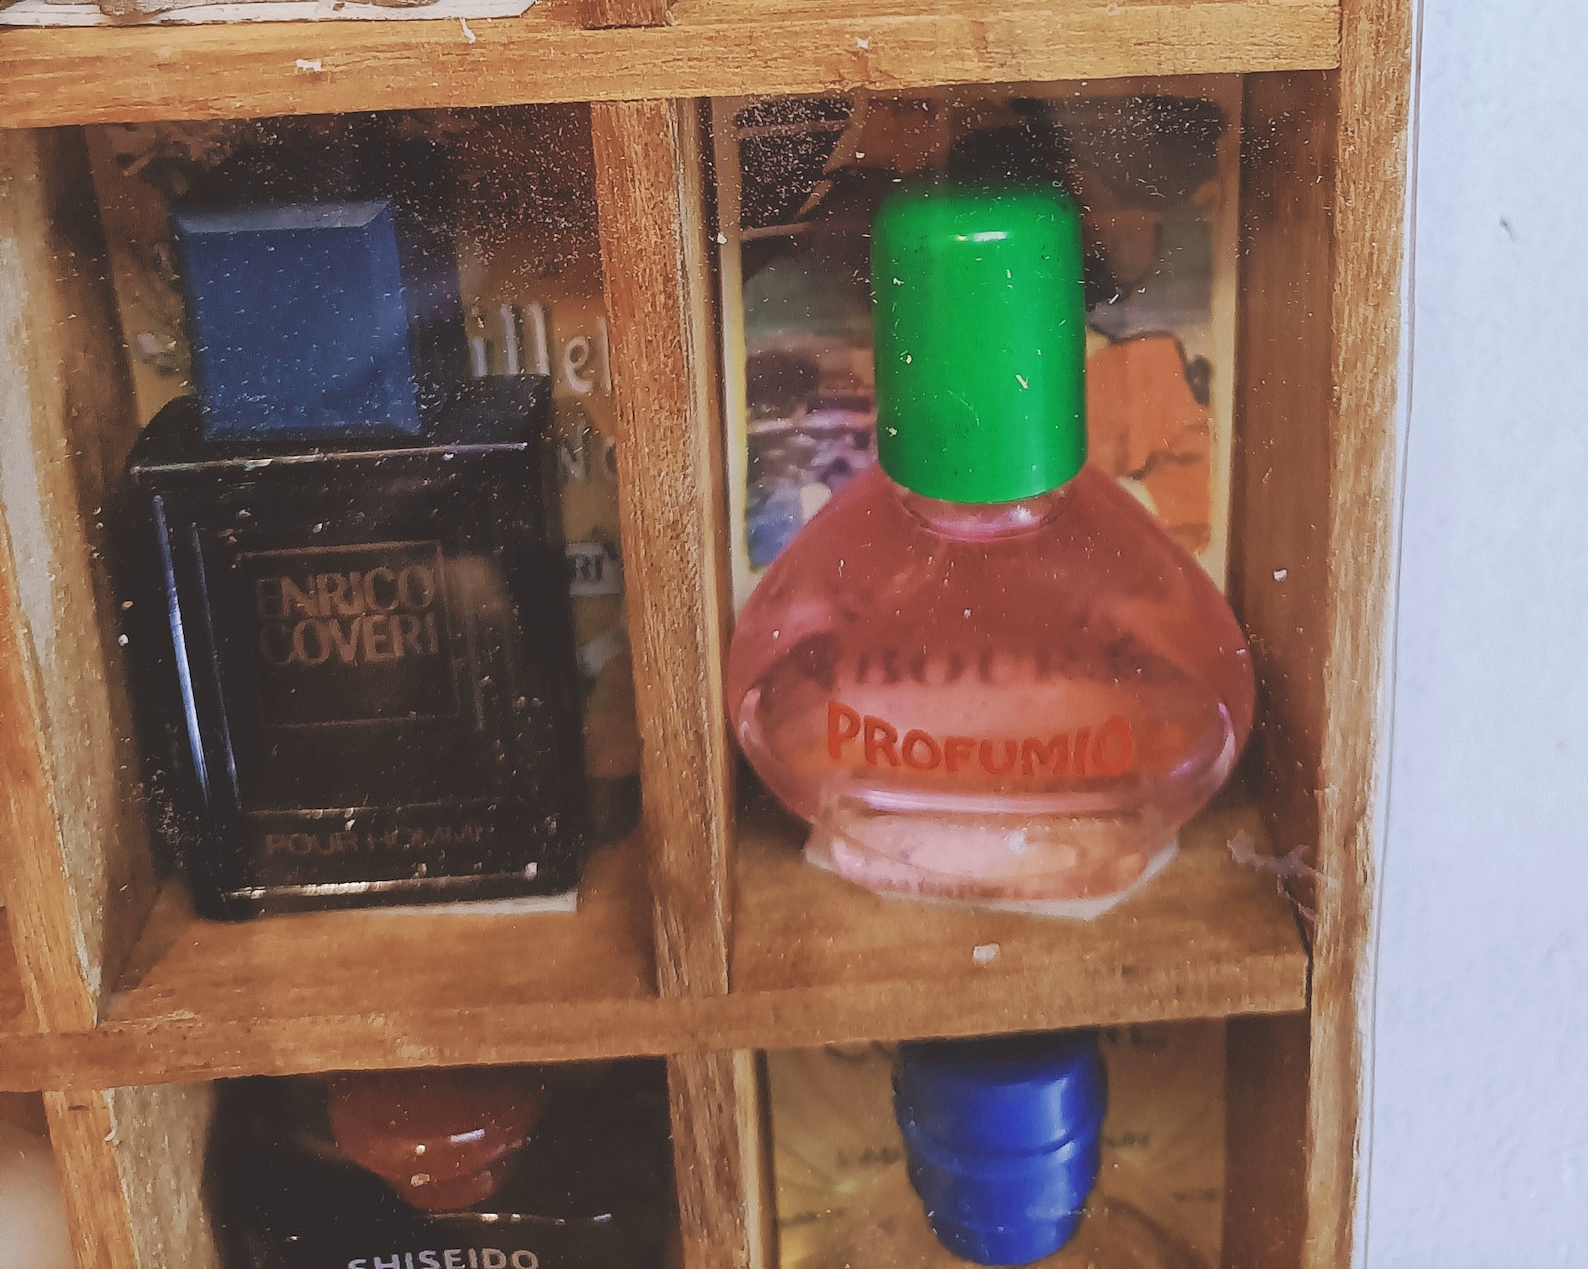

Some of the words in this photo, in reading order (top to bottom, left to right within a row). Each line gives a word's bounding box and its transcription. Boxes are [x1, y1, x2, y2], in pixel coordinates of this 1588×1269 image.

[256, 565, 437, 620] ENRICO
[260, 612, 439, 667] COVERI
[347, 1248, 540, 1269] SHISEIDO
